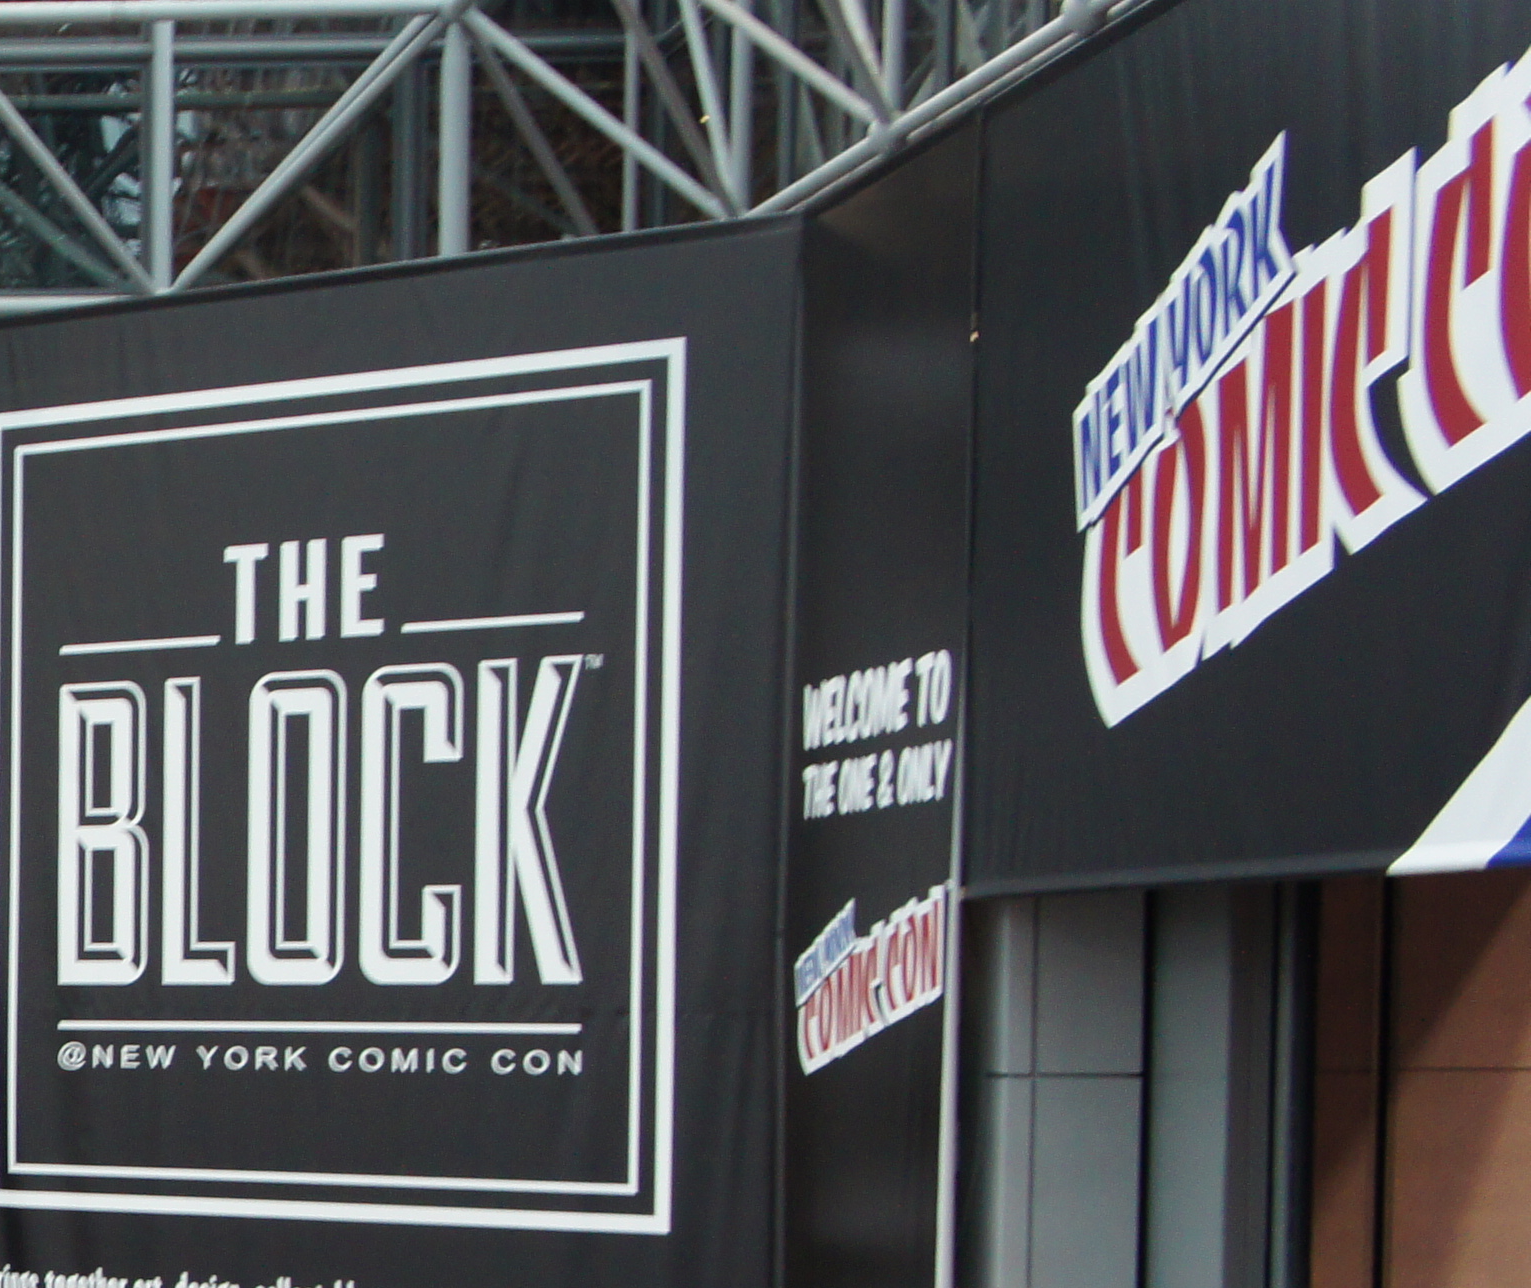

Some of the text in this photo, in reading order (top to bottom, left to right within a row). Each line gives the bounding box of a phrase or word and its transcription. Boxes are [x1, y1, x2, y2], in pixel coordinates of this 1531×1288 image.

[1079, 158, 1279, 500] NEW YORK
[1097, 203, 1395, 690] COMIC
[223, 533, 385, 645] THE
[801, 648, 953, 752] WELCOME TO
[801, 737, 953, 821] THE ONE & ONLY
[802, 898, 940, 1061] COMIC CON
[57, 1039, 585, 1076] @NEW YORK COMIC CON
